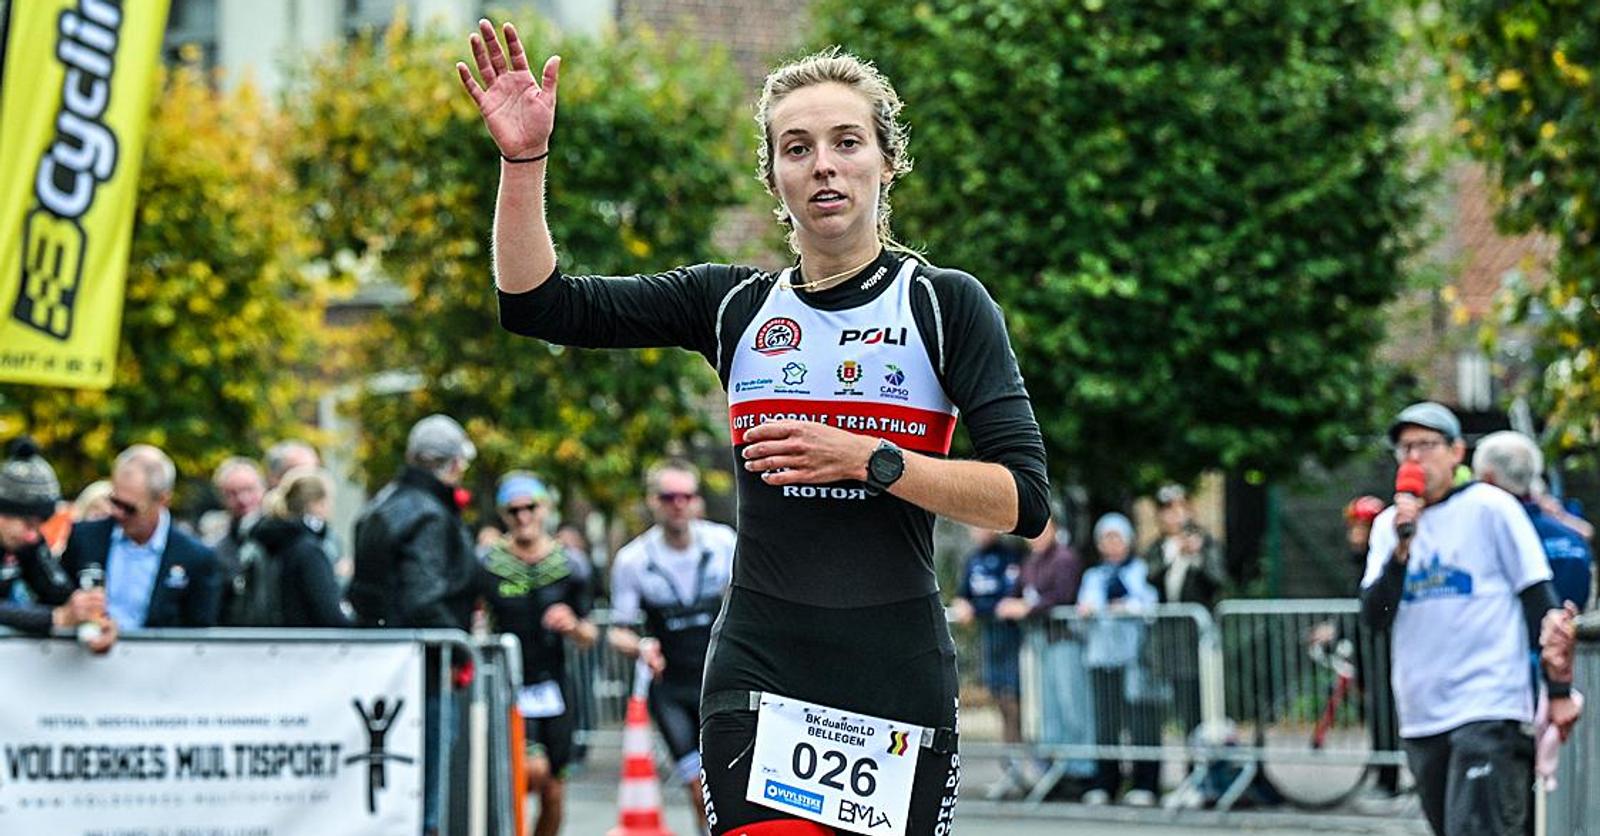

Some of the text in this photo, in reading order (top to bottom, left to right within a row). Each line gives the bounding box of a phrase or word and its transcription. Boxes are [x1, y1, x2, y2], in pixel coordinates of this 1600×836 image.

[838, 327, 908, 347] POLI
[783, 485, 867, 500] ROTOR
[805, 713, 821, 726] BK
[860, 726, 875, 737] LD
[807, 726, 866, 748] BELLEGEM
[174, 742, 342, 779] MULTISPORT
[792, 741, 879, 798] 026
